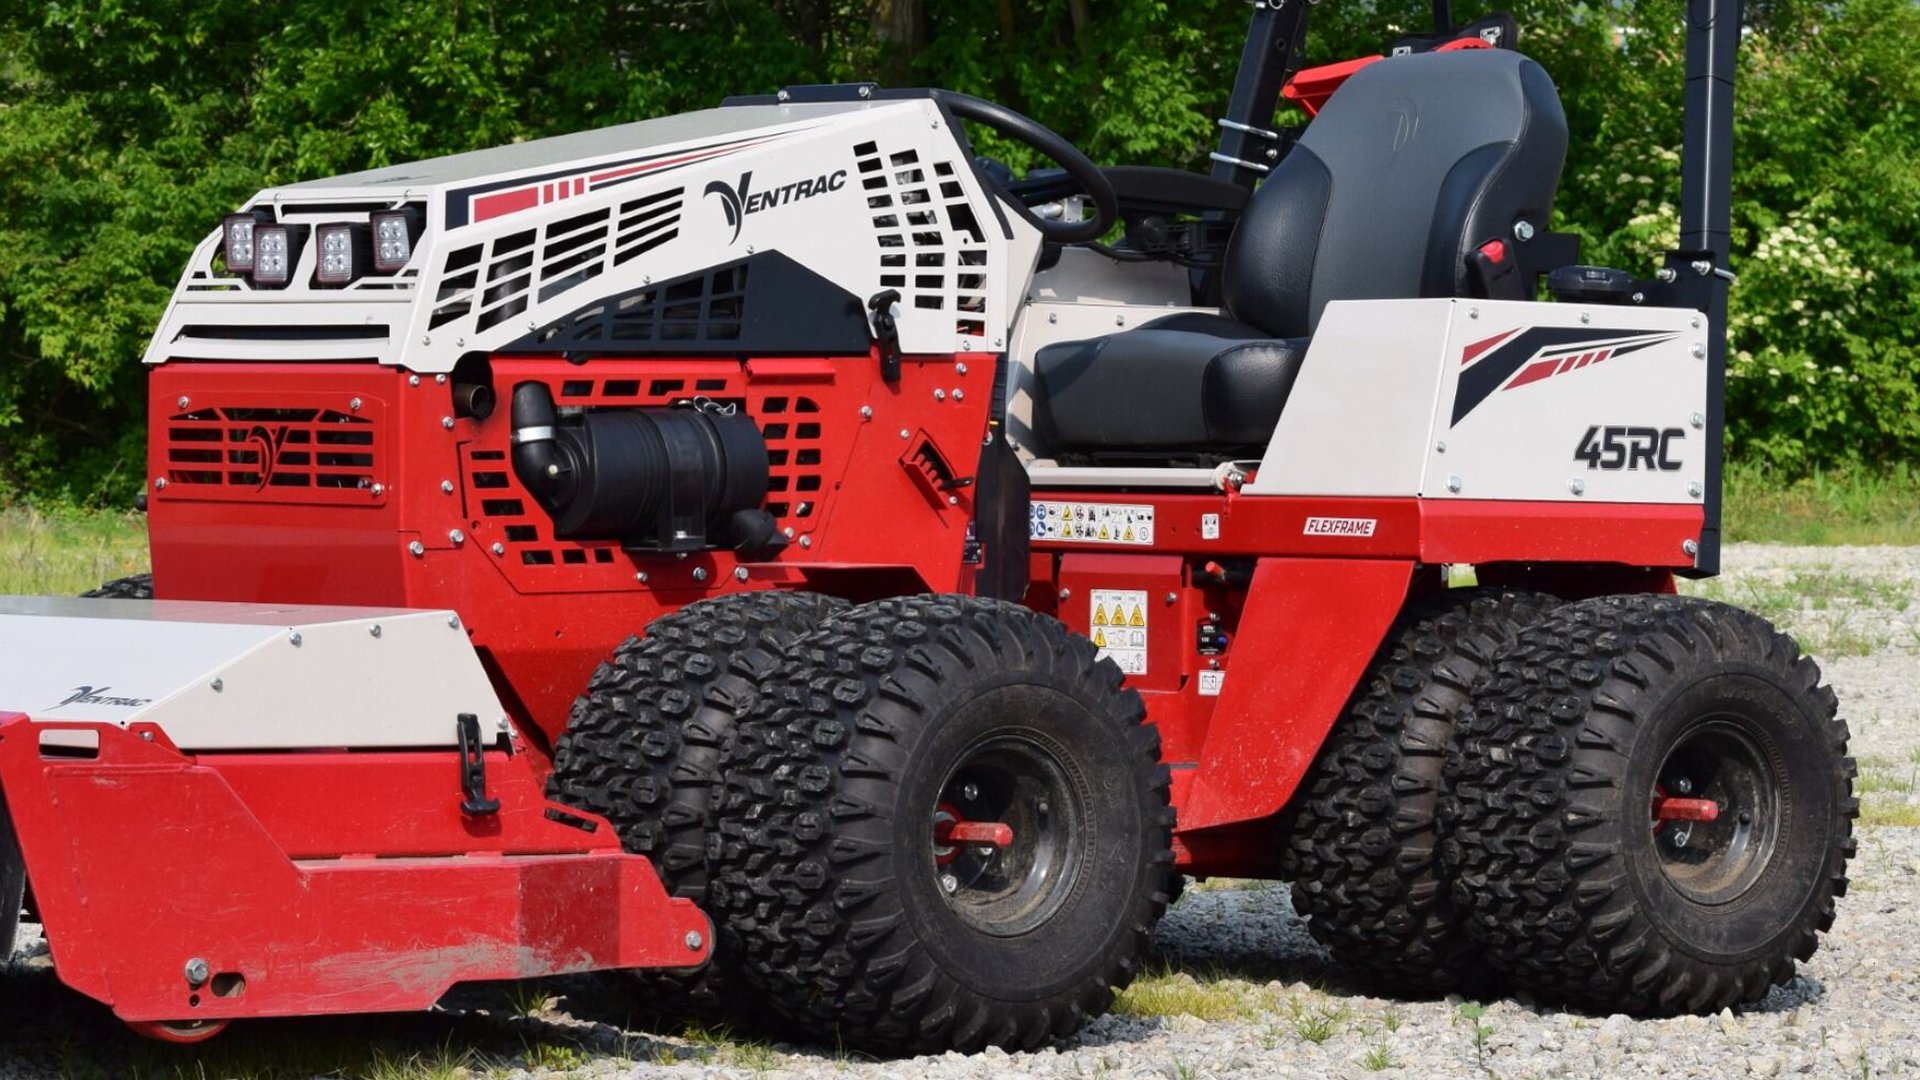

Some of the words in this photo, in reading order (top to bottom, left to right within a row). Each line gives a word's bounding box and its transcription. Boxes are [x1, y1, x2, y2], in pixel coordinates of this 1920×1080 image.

[703, 169, 847, 246] VENTRAC
[1574, 424, 1687, 472] 45RC
[1306, 519, 1373, 536] FLEXFRAME
[40, 685, 152, 711] VENTRAC
